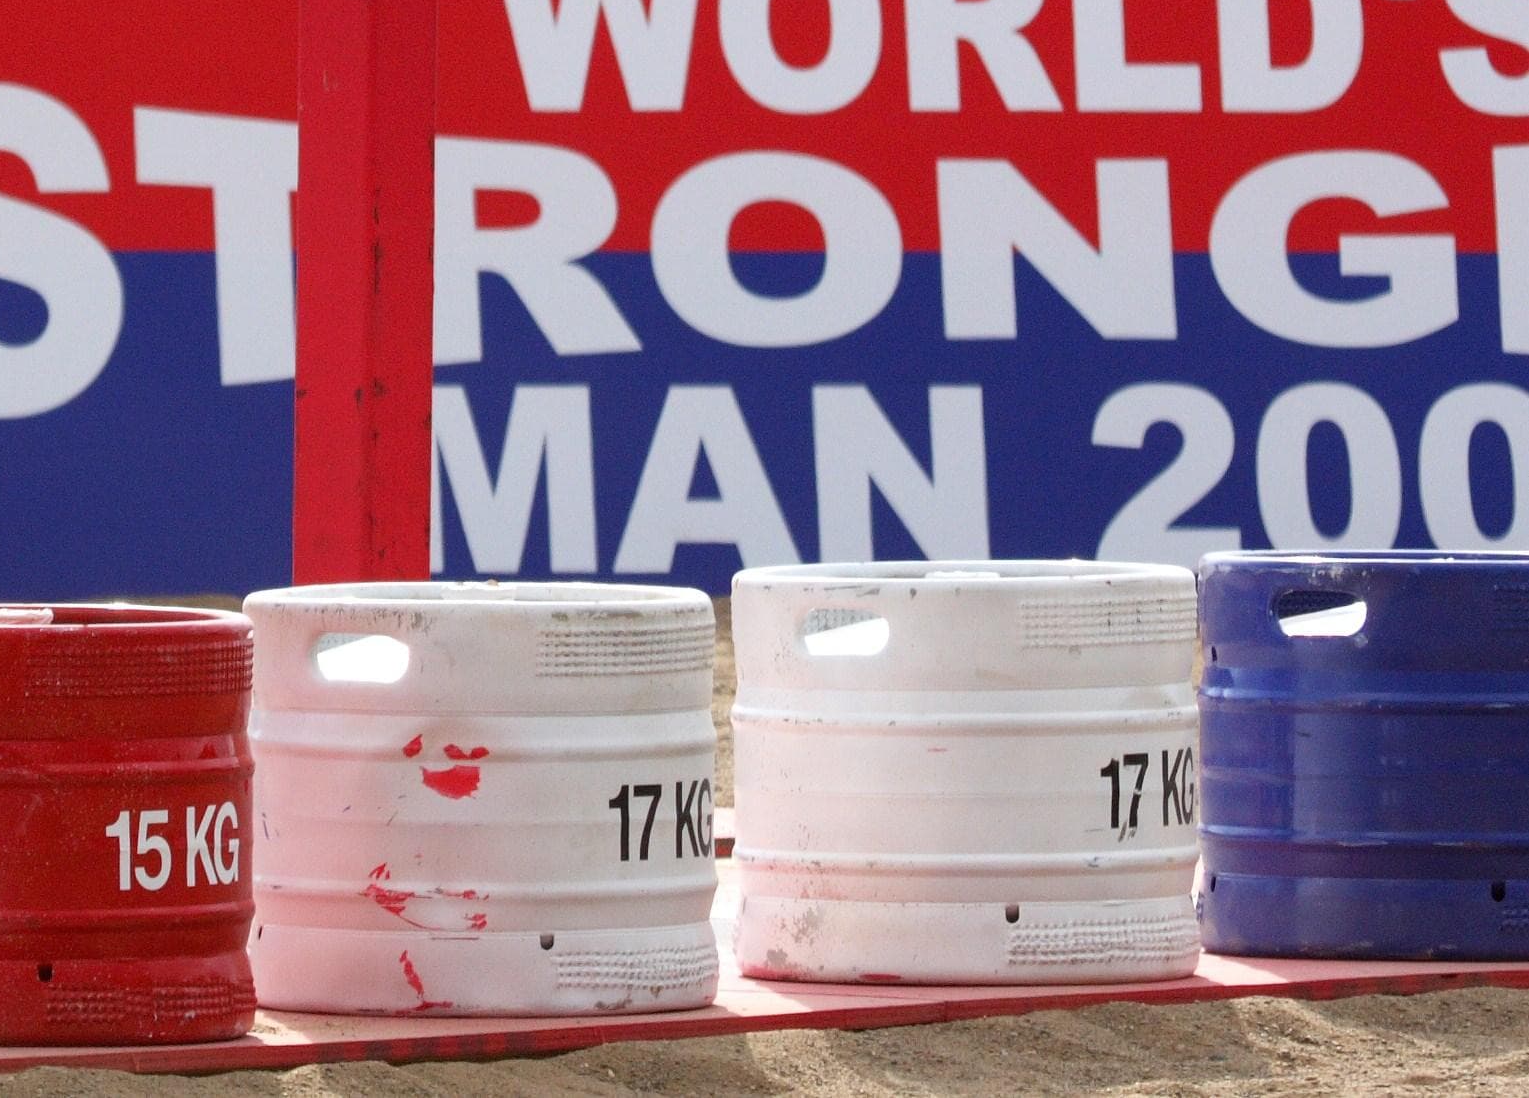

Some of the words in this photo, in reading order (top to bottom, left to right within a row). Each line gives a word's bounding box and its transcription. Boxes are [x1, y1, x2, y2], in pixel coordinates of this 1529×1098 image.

[430, 383, 991, 575] MAN
[608, 784, 662, 862] 17
[675, 778, 712, 859] KG
[1099, 752, 1149, 830] 17
[1161, 746, 1194, 827] KG
[105, 808, 172, 892] 15
[186, 801, 240, 888] KG
